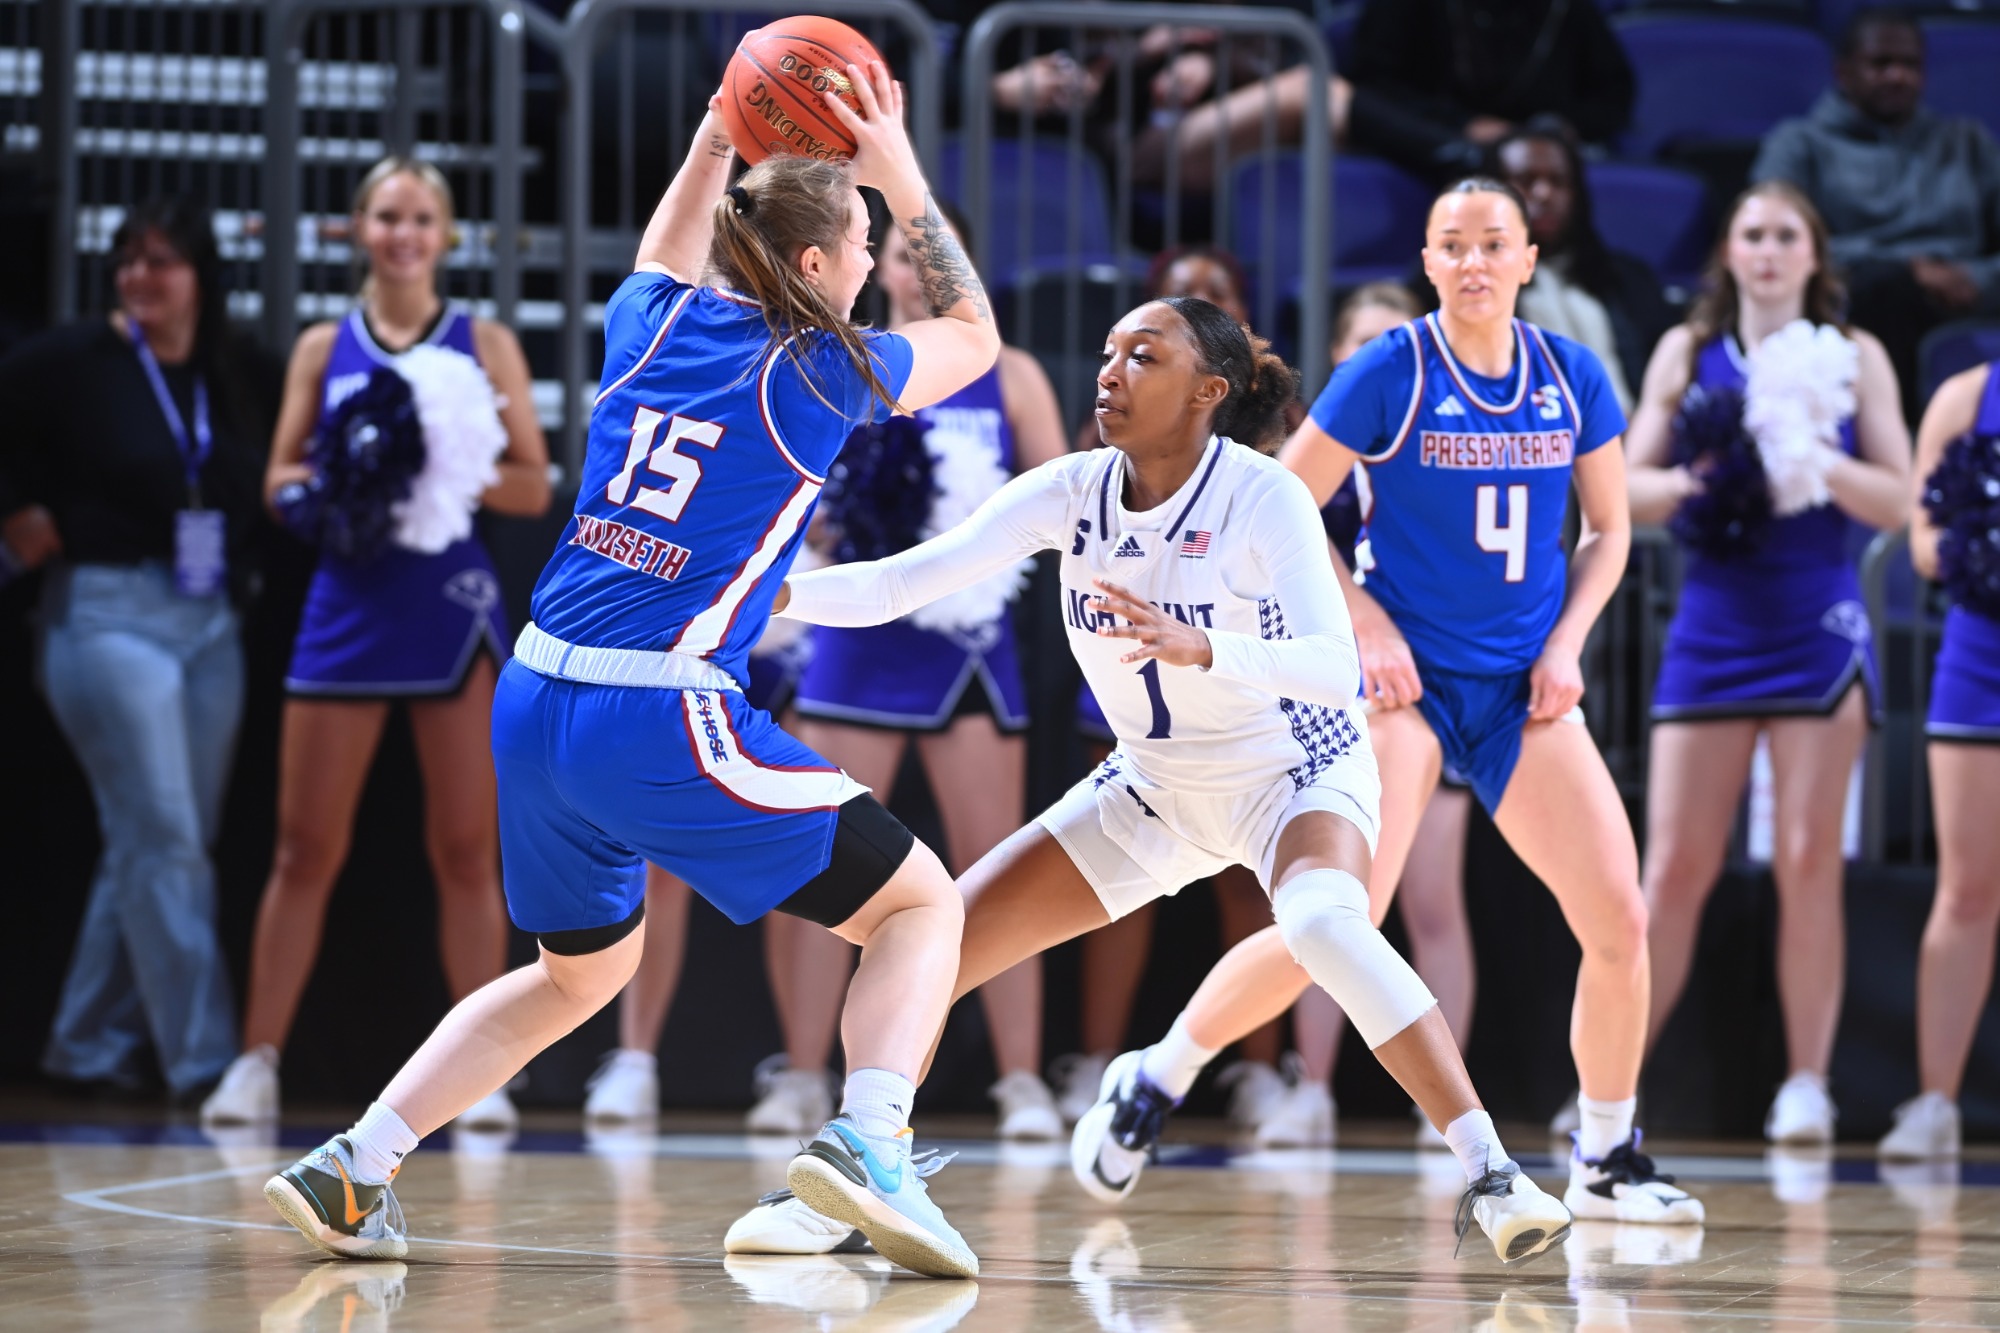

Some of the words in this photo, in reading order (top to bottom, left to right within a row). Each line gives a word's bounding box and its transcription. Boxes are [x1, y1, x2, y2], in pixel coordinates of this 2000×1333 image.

[606, 403, 728, 525] 15
[1420, 429, 1574, 470] PRESBYTERIAN
[1114, 549, 1146, 558] adidas
[1475, 484, 1529, 583] 4
[1135, 657, 1172, 739] 1
